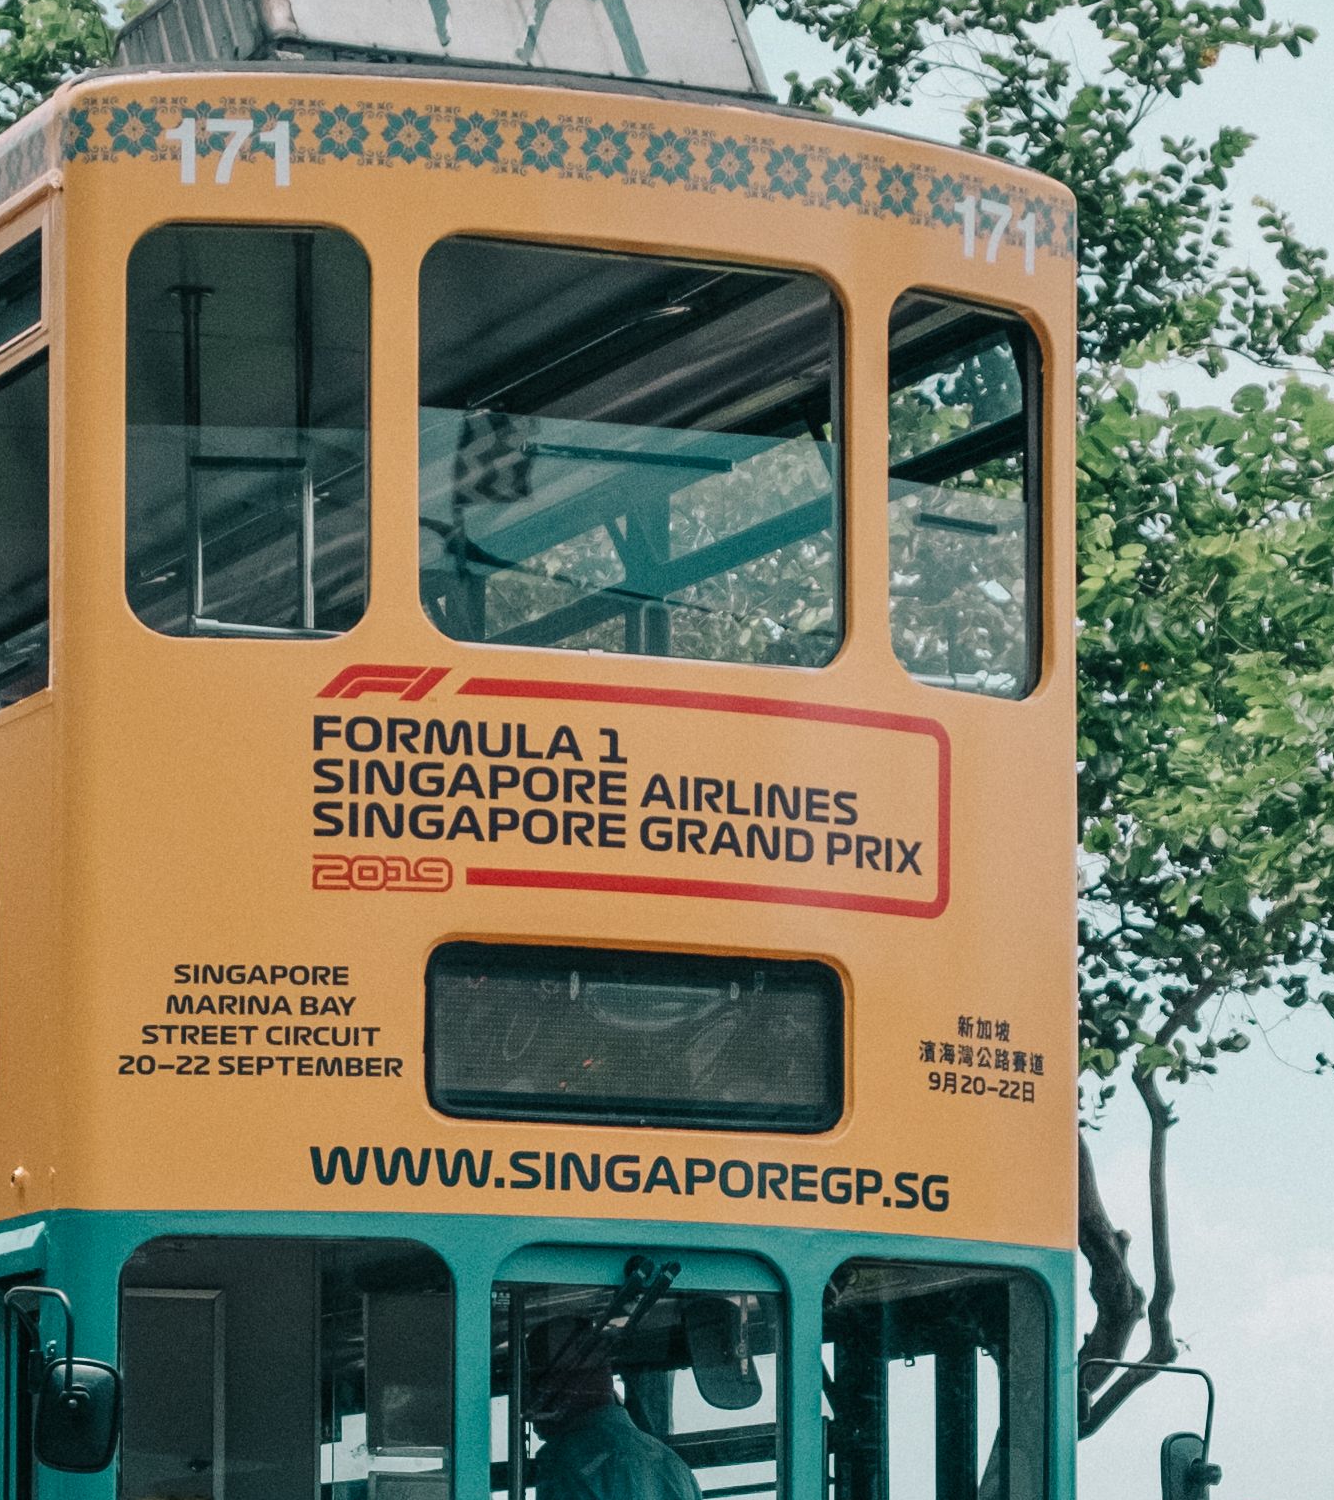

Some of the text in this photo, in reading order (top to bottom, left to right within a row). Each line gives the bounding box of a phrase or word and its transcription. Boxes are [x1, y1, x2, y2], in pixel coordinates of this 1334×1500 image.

[165, 117, 291, 188] 171
[954, 195, 1036, 276] 171
[312, 715, 628, 764] FORMULA 1
[312, 758, 859, 826] SINGAPORE AIRLINES
[312, 801, 922, 876] SINGAPORE GRAND PRIX
[312, 853, 454, 893] 2019
[174, 963, 350, 986] SINGAPORE
[165, 994, 357, 1017] MARINA BAY
[141, 1024, 381, 1047] STREET CIRCUIT
[957, 1014, 1011, 1043] 新加坡
[217, 1055, 404, 1078] SEPTEMBER
[309, 1144, 951, 1213] WWW.SINGAPOREGP.SG
